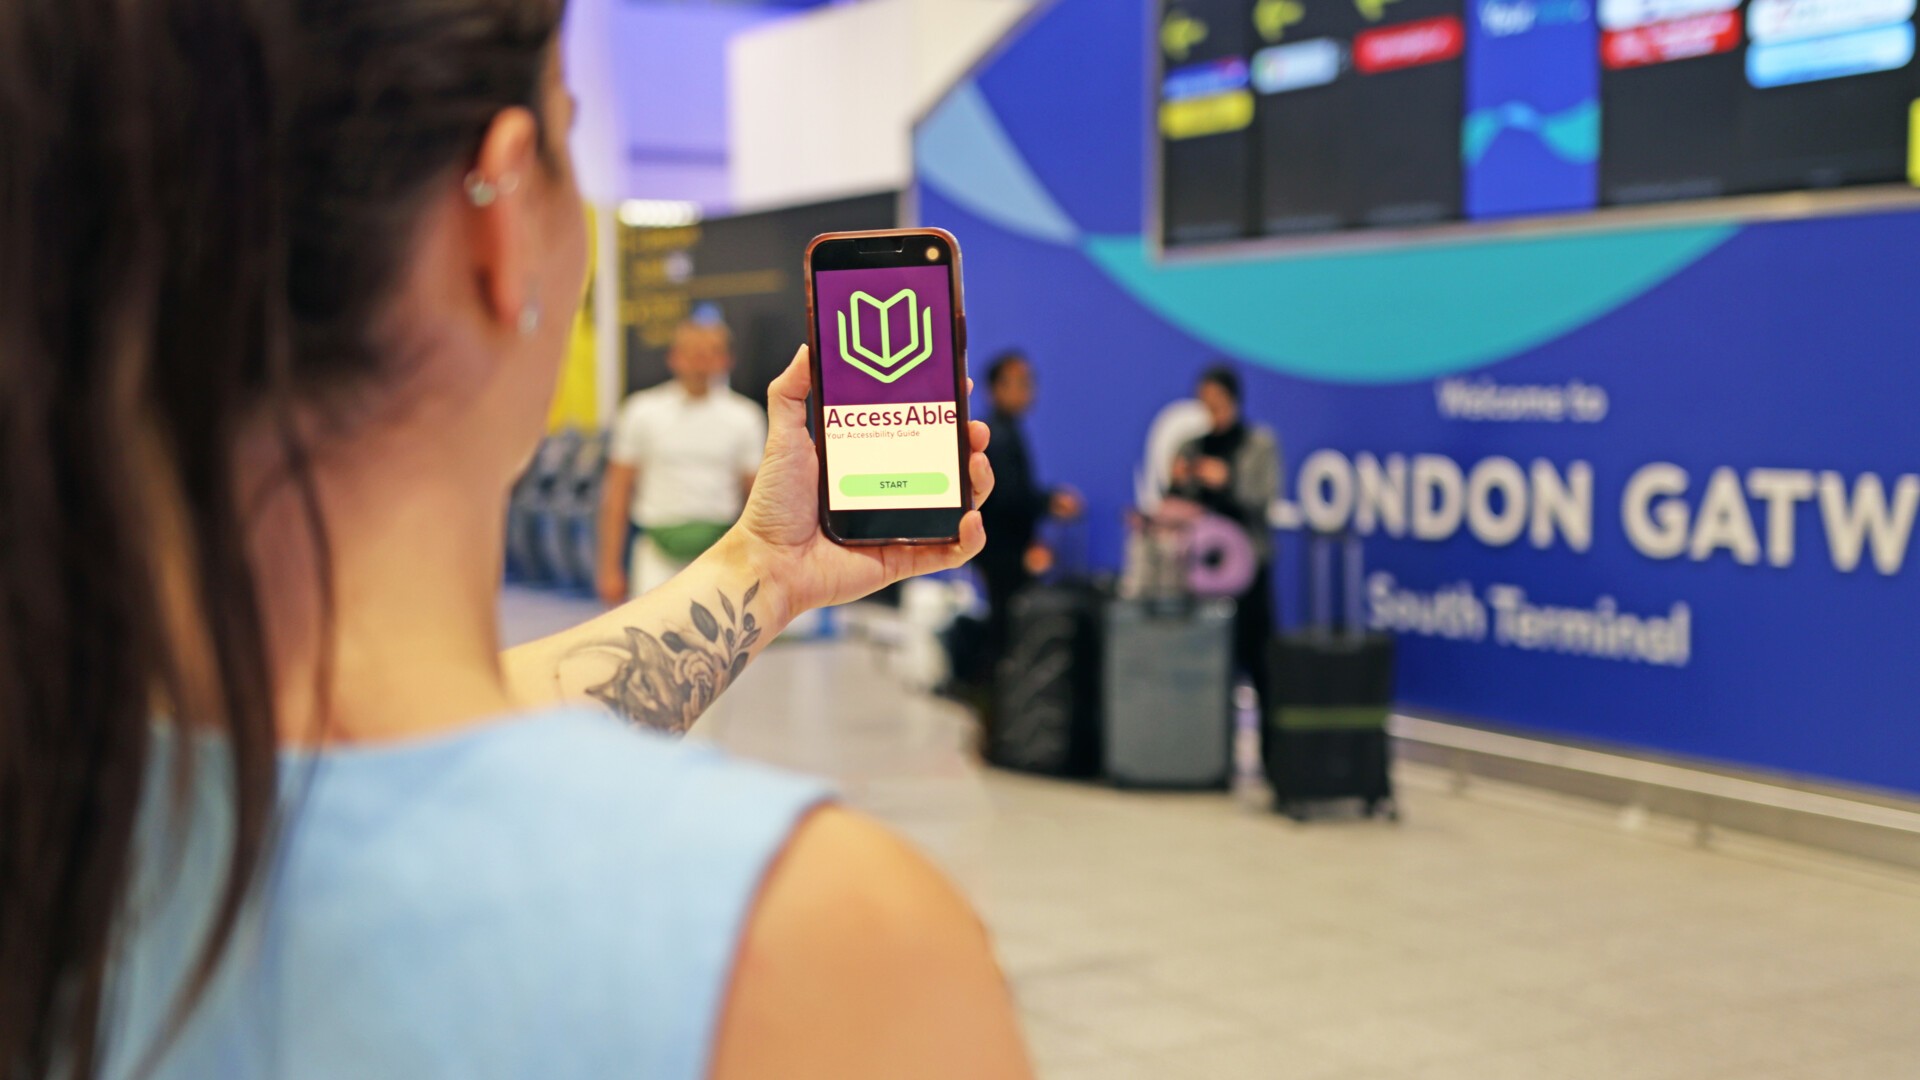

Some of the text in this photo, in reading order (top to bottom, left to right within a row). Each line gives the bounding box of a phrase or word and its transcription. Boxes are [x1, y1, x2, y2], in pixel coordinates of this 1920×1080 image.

[1437, 376, 1609, 422] Welcome to
[826, 405, 957, 428] AccessAble
[827, 429, 920, 440] Your Accessibility Guide
[880, 480, 908, 489] START
[1266, 449, 1920, 576] ONDON GATW
[1368, 572, 1692, 668] South Terminal
